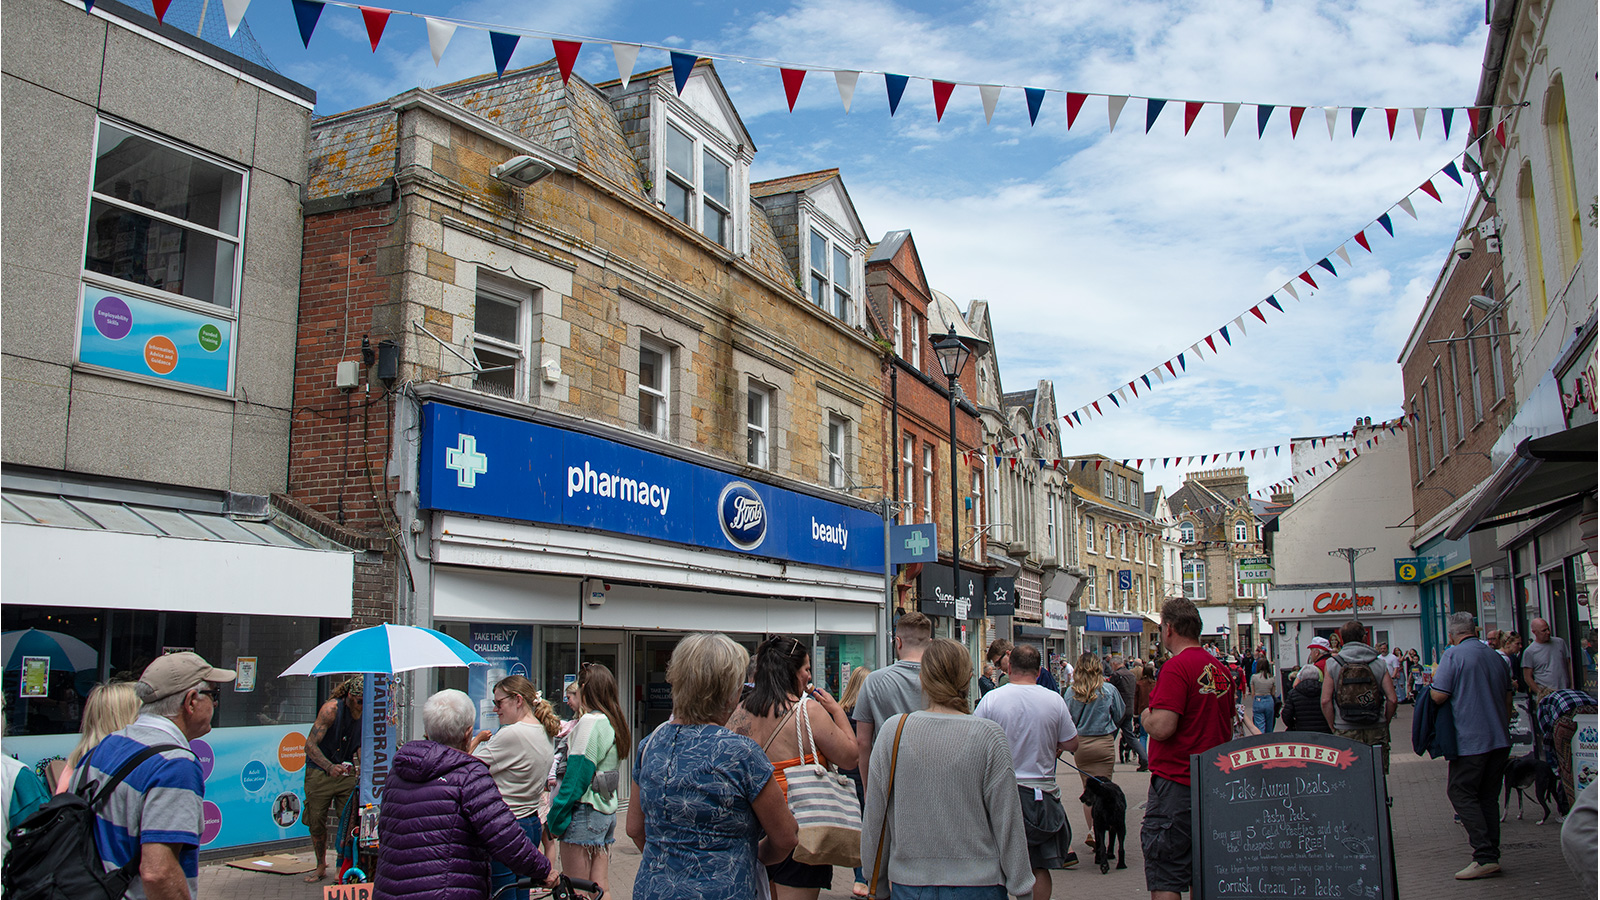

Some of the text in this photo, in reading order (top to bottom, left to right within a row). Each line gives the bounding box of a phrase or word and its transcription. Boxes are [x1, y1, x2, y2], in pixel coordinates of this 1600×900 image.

[150, 358, 171, 366] Guidance
[567, 461, 670, 516] pharmacy
[730, 496, 763, 532] Boots
[811, 516, 849, 550] beauty
[1120, 575, 1130, 589] S
[1103, 616, 1130, 632] WHSmith
[473, 632, 490, 641] TAKE
[490, 632, 502, 641] THE
[473, 643, 510, 652] CHALLENGE
[372, 673, 388, 799] HAIRBRAIDS
[1231, 745, 1337, 767] PAULINES
[1225, 773, 1330, 808] Take Away Deals
[1262, 807, 1309, 830] Pasty Pack
[1212, 829, 1228, 846] Buy
[1230, 830, 1242, 846] any
[1246, 826, 1257, 839] 5
[1261, 824, 1280, 837] Cold
[1317, 821, 1331, 835] and
[1334, 820, 1348, 840] get
[1226, 835, 1327, 857] the cheapest one FREE!
[1214, 864, 1229, 875] Take
[1230, 864, 1246, 874] them
[1261, 863, 1269, 872] to
[1270, 865, 1285, 876] enjoy
[1286, 862, 1297, 872] and
[1299, 863, 1312, 877] they
[1313, 864, 1325, 872] can
[1325, 862, 1333, 871] be
[1218, 875, 1341, 897] Cornish Cream Tea Packs
